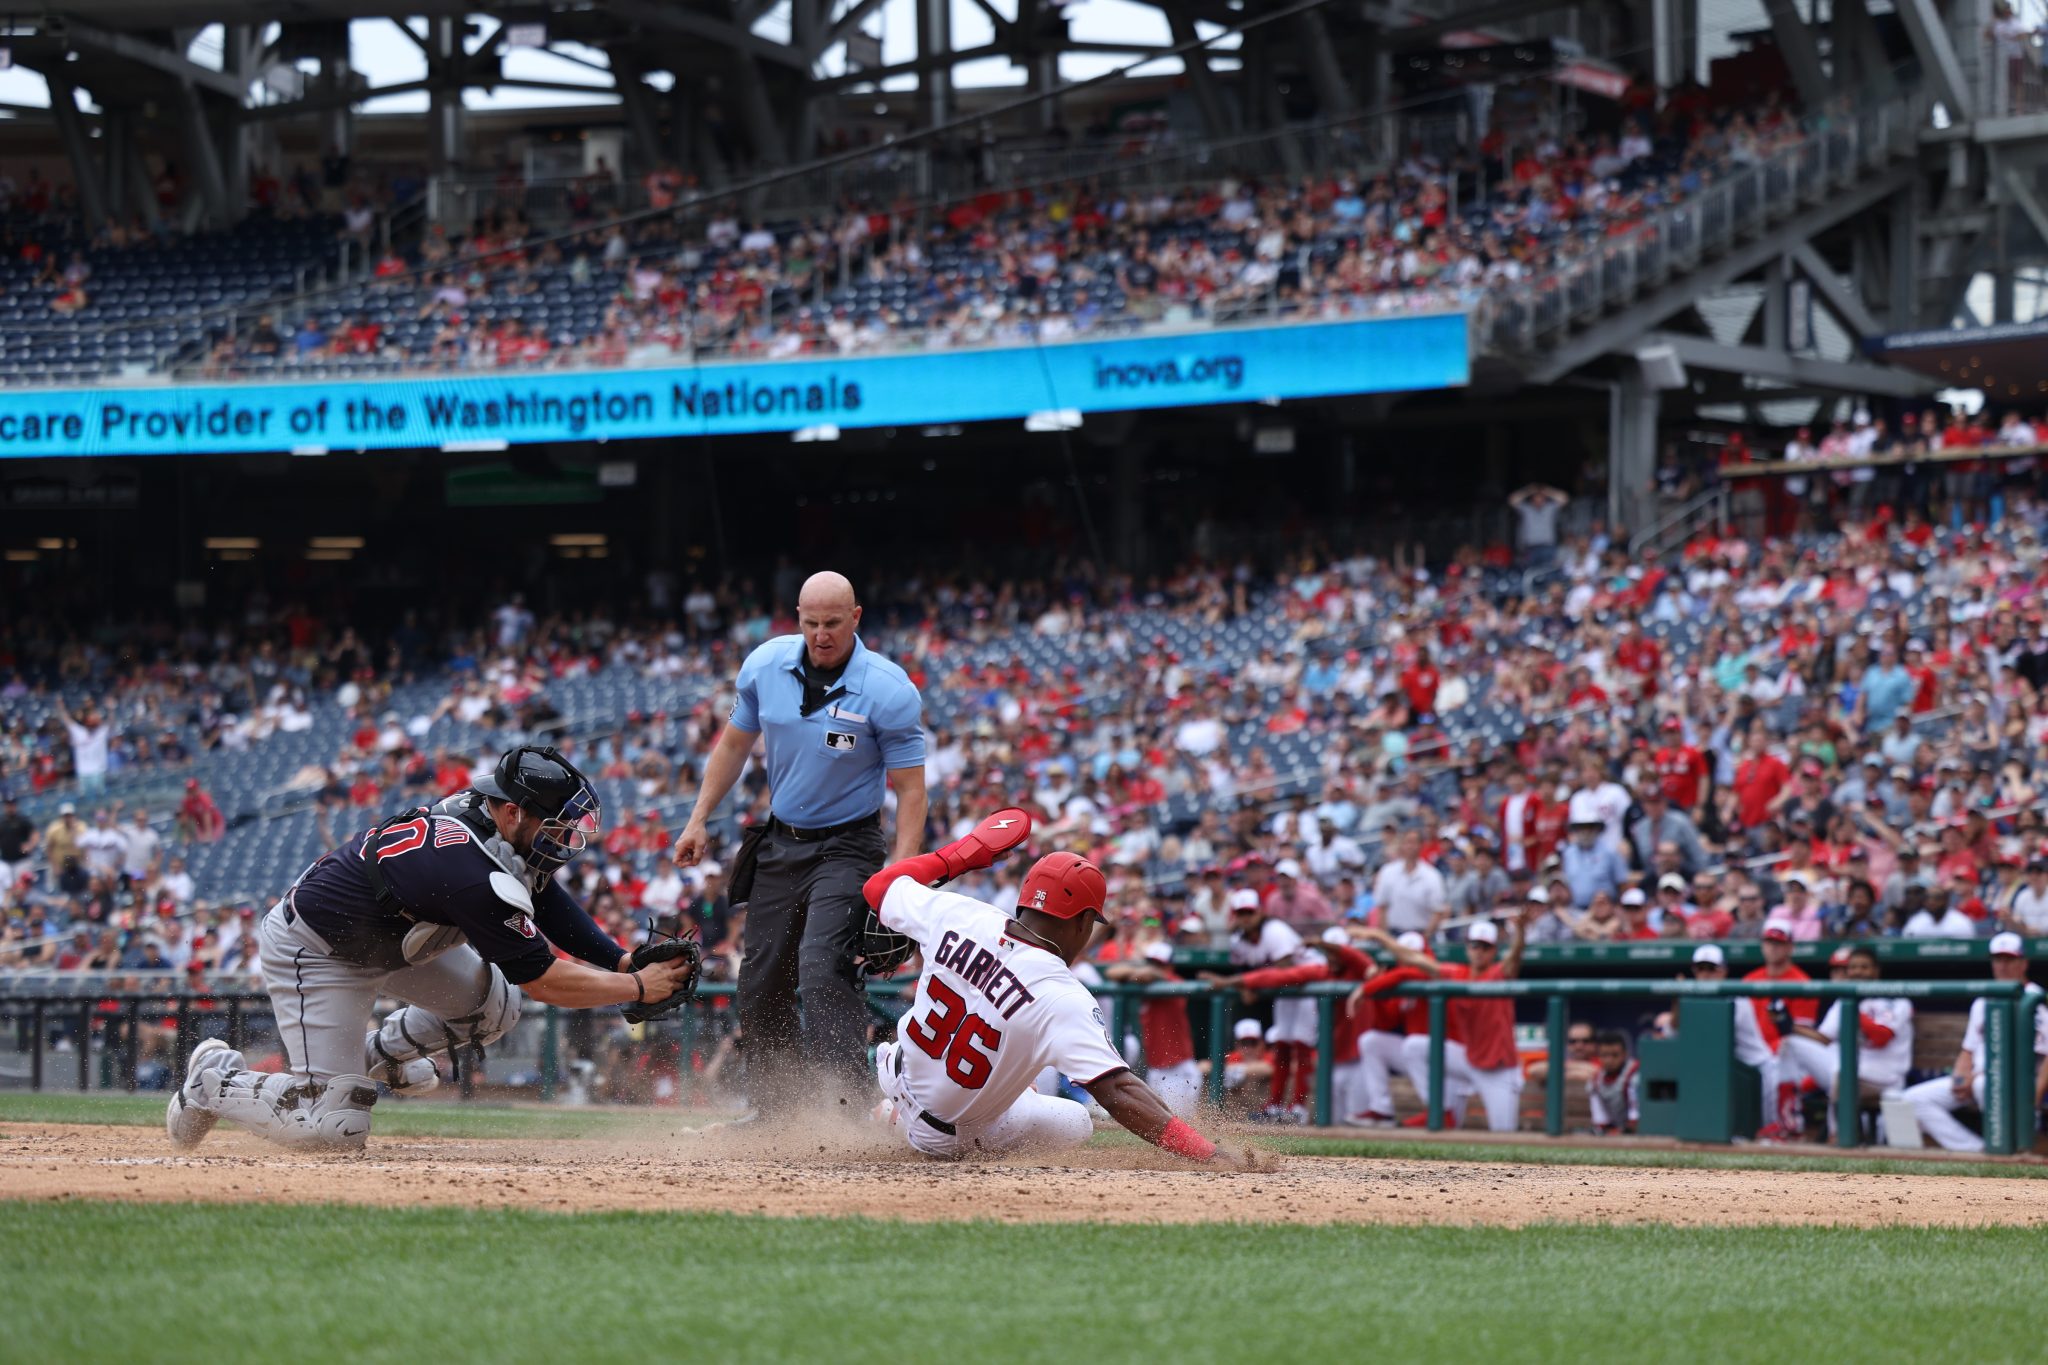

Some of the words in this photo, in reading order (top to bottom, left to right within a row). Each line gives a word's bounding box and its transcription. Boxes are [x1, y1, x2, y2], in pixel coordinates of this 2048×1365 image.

[1094, 355, 1244, 389] inova.org
[0, 413, 82, 441] care
[101, 401, 272, 438] Provider
[290, 399, 327, 433] of
[347, 400, 406, 432] the
[425, 390, 653, 433] Washington
[672, 374, 863, 419] Nationals
[1034, 889, 1047, 901] 36
[934, 930, 1036, 1022] GARRETT
[906, 974, 1001, 1090] 36
